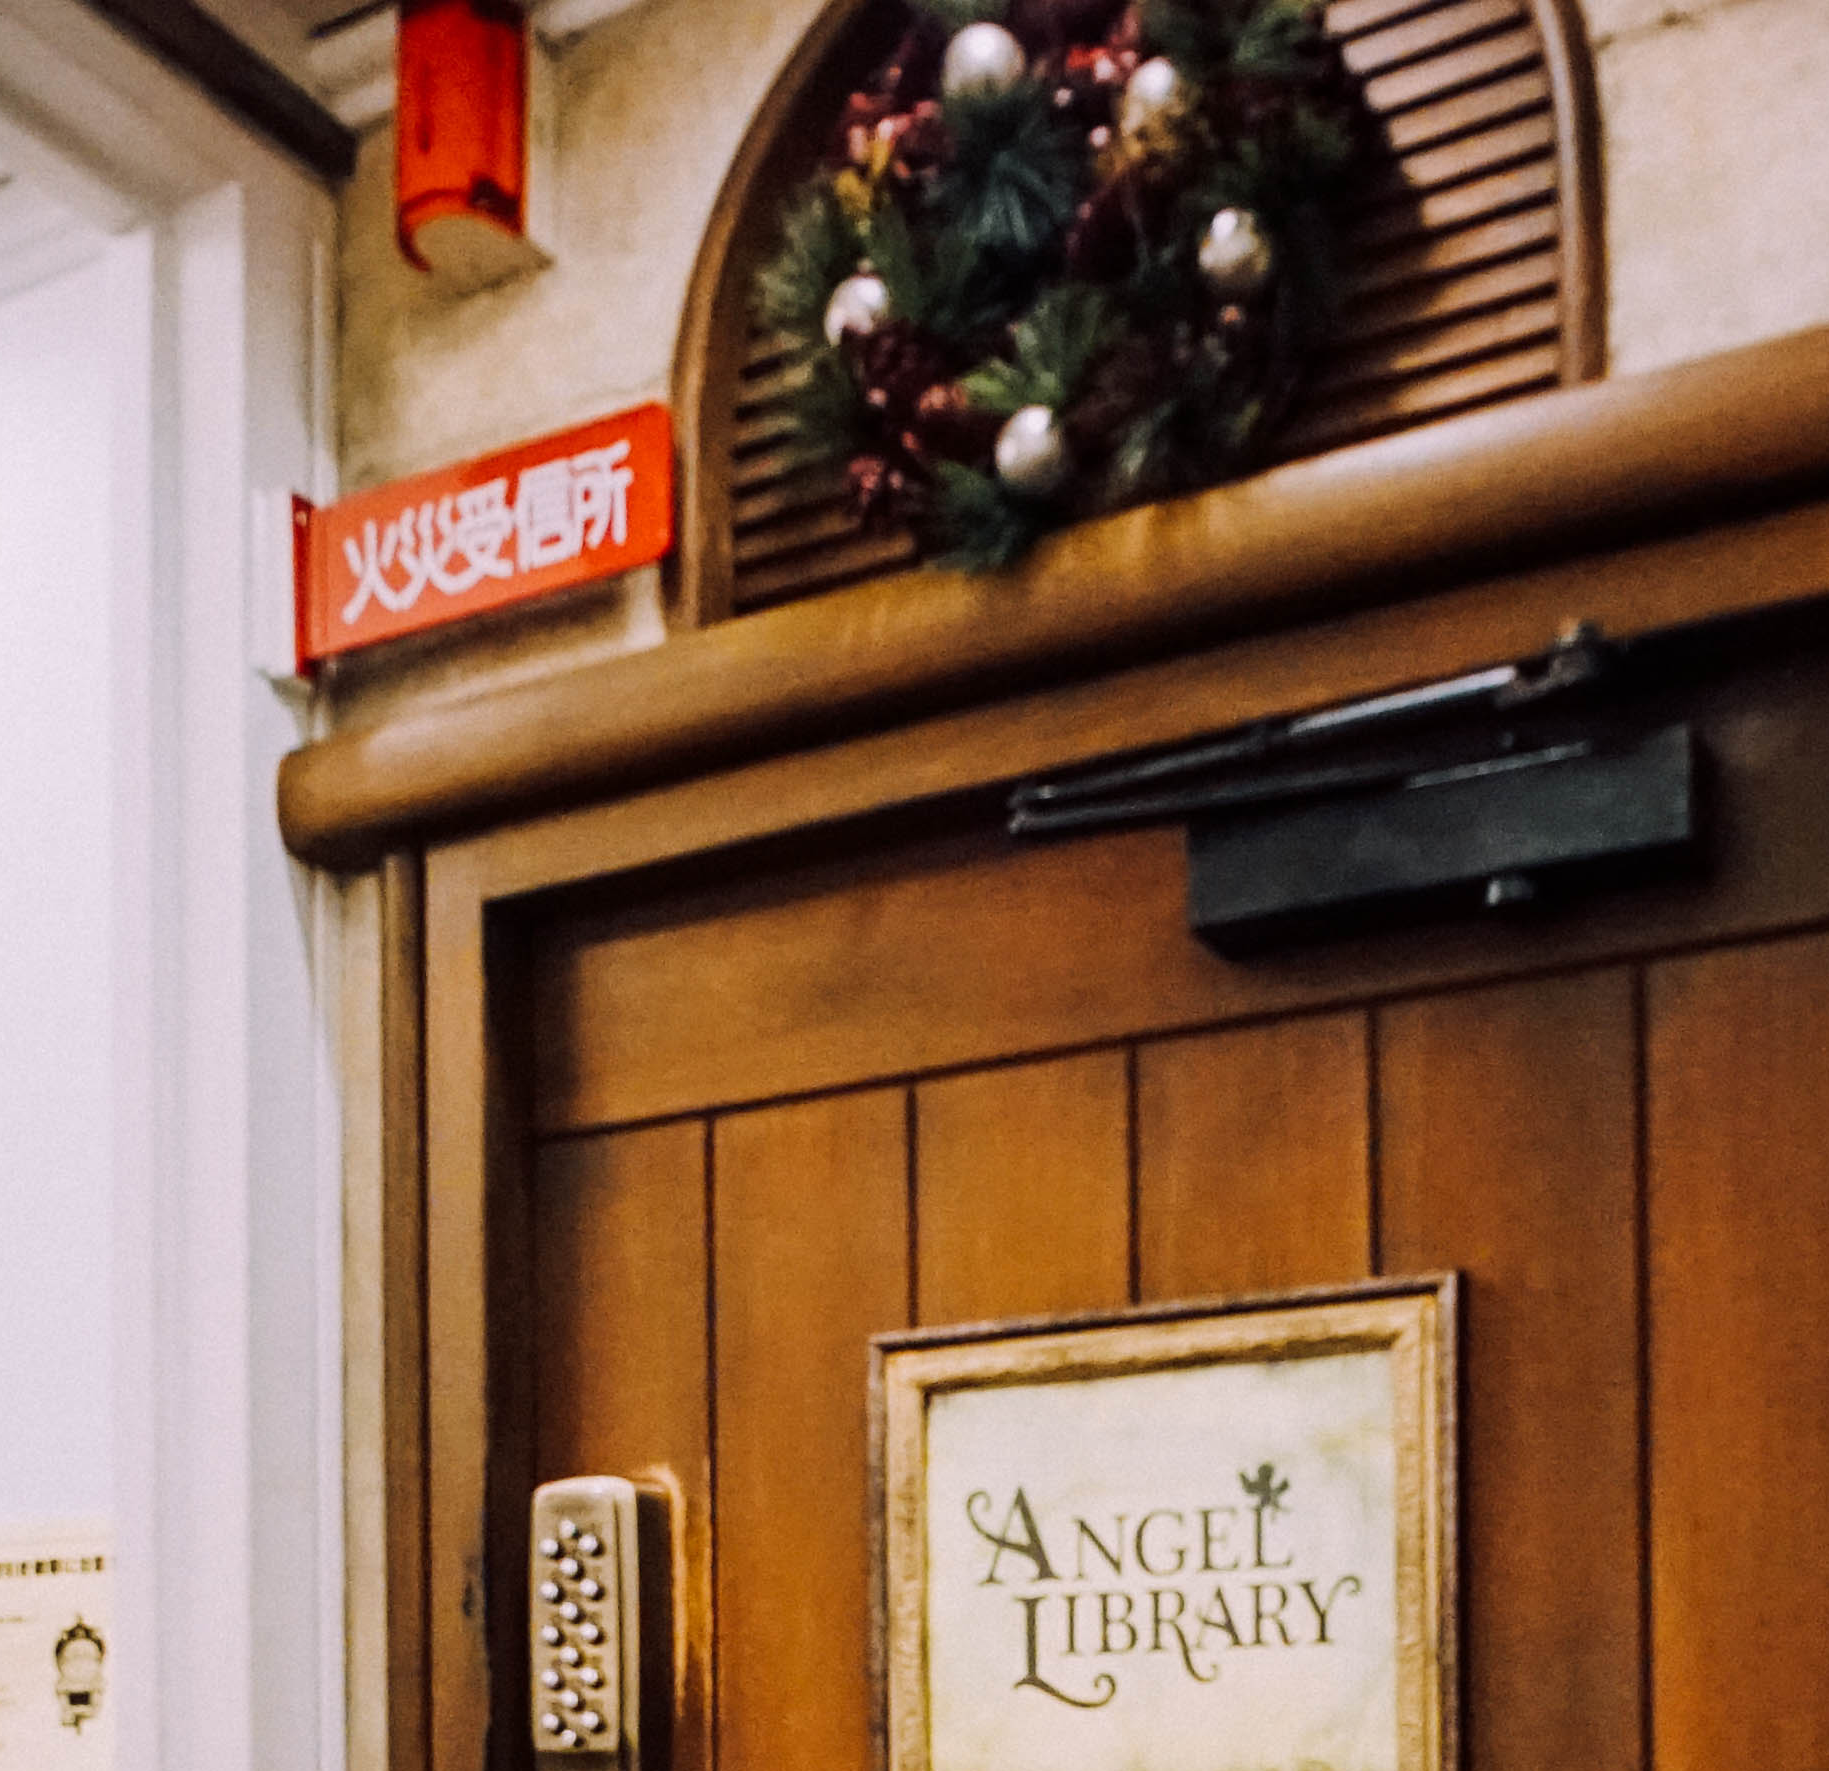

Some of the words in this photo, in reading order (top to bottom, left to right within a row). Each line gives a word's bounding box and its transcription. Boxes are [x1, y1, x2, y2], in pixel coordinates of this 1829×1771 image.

[342, 440, 634, 625] 火災受信所
[966, 1486, 1293, 1587] ANGEL
[1013, 1575, 1363, 1709] LIBRARY
